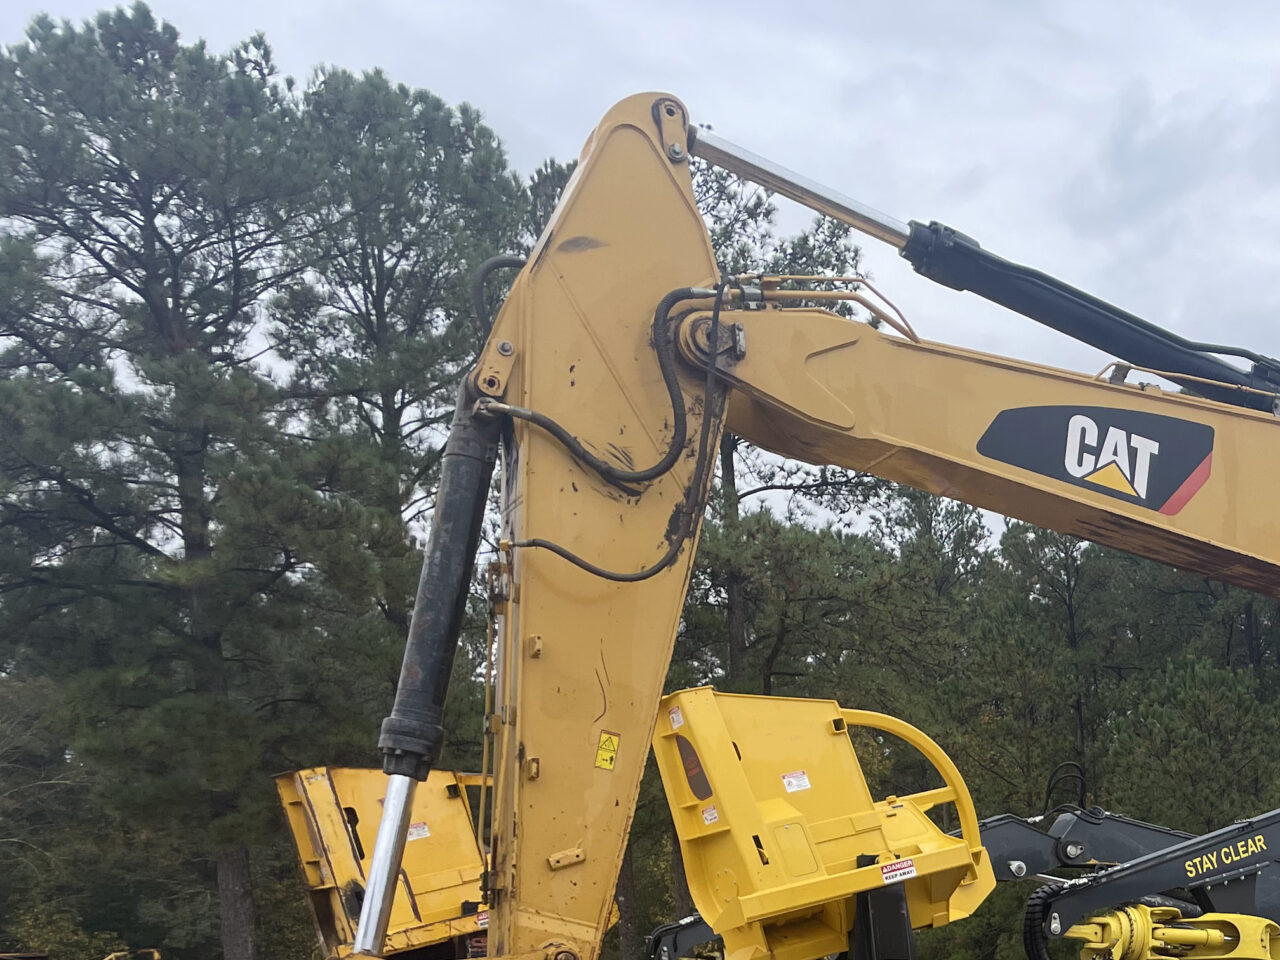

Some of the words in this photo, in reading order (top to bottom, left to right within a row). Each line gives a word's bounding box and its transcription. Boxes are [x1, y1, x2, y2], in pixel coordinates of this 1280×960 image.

[1064, 414, 1160, 499] CAT
[887, 860, 913, 871] DANGER
[1184, 850, 1218, 878] STAY
[1220, 834, 1267, 864] CLEAR
[885, 873, 898, 881] KEEP
